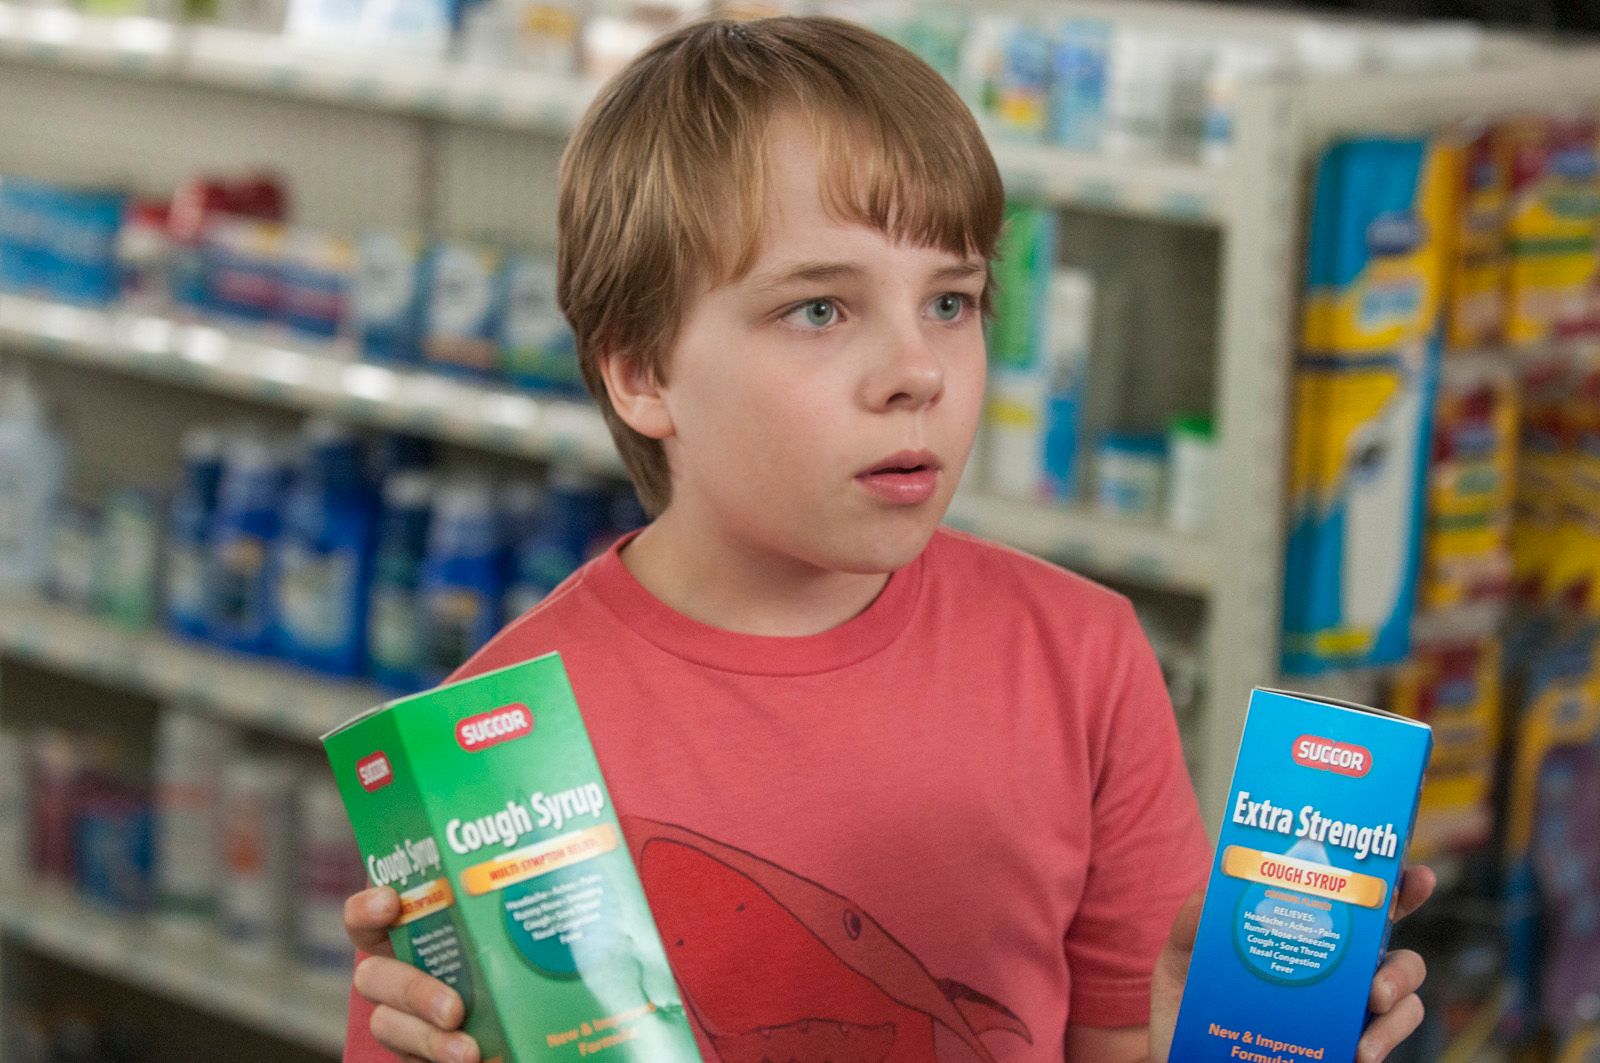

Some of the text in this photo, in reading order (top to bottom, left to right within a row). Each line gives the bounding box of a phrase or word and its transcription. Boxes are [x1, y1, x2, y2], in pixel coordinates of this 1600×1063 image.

[461, 709, 528, 746] SUCCOR
[1298, 741, 1365, 771] SUCCOR
[445, 782, 605, 855] Cough Syrup
[1232, 790, 1398, 860] Extra Strength
[367, 844, 412, 887] Cough
[1260, 861, 1347, 893] COUGH SYRUP
[1244, 911, 1340, 939] Headache Aches Pains
[1273, 906, 1315, 922] RELIEVES:
[1244, 922, 1336, 951] Runny Nose Sneezing
[1247, 934, 1328, 959] Cough Sore Throat
[1249, 946, 1320, 968] Nasal Congestion
[1271, 962, 1294, 973] Fever
[1208, 1023, 1325, 1060] New & Improved
